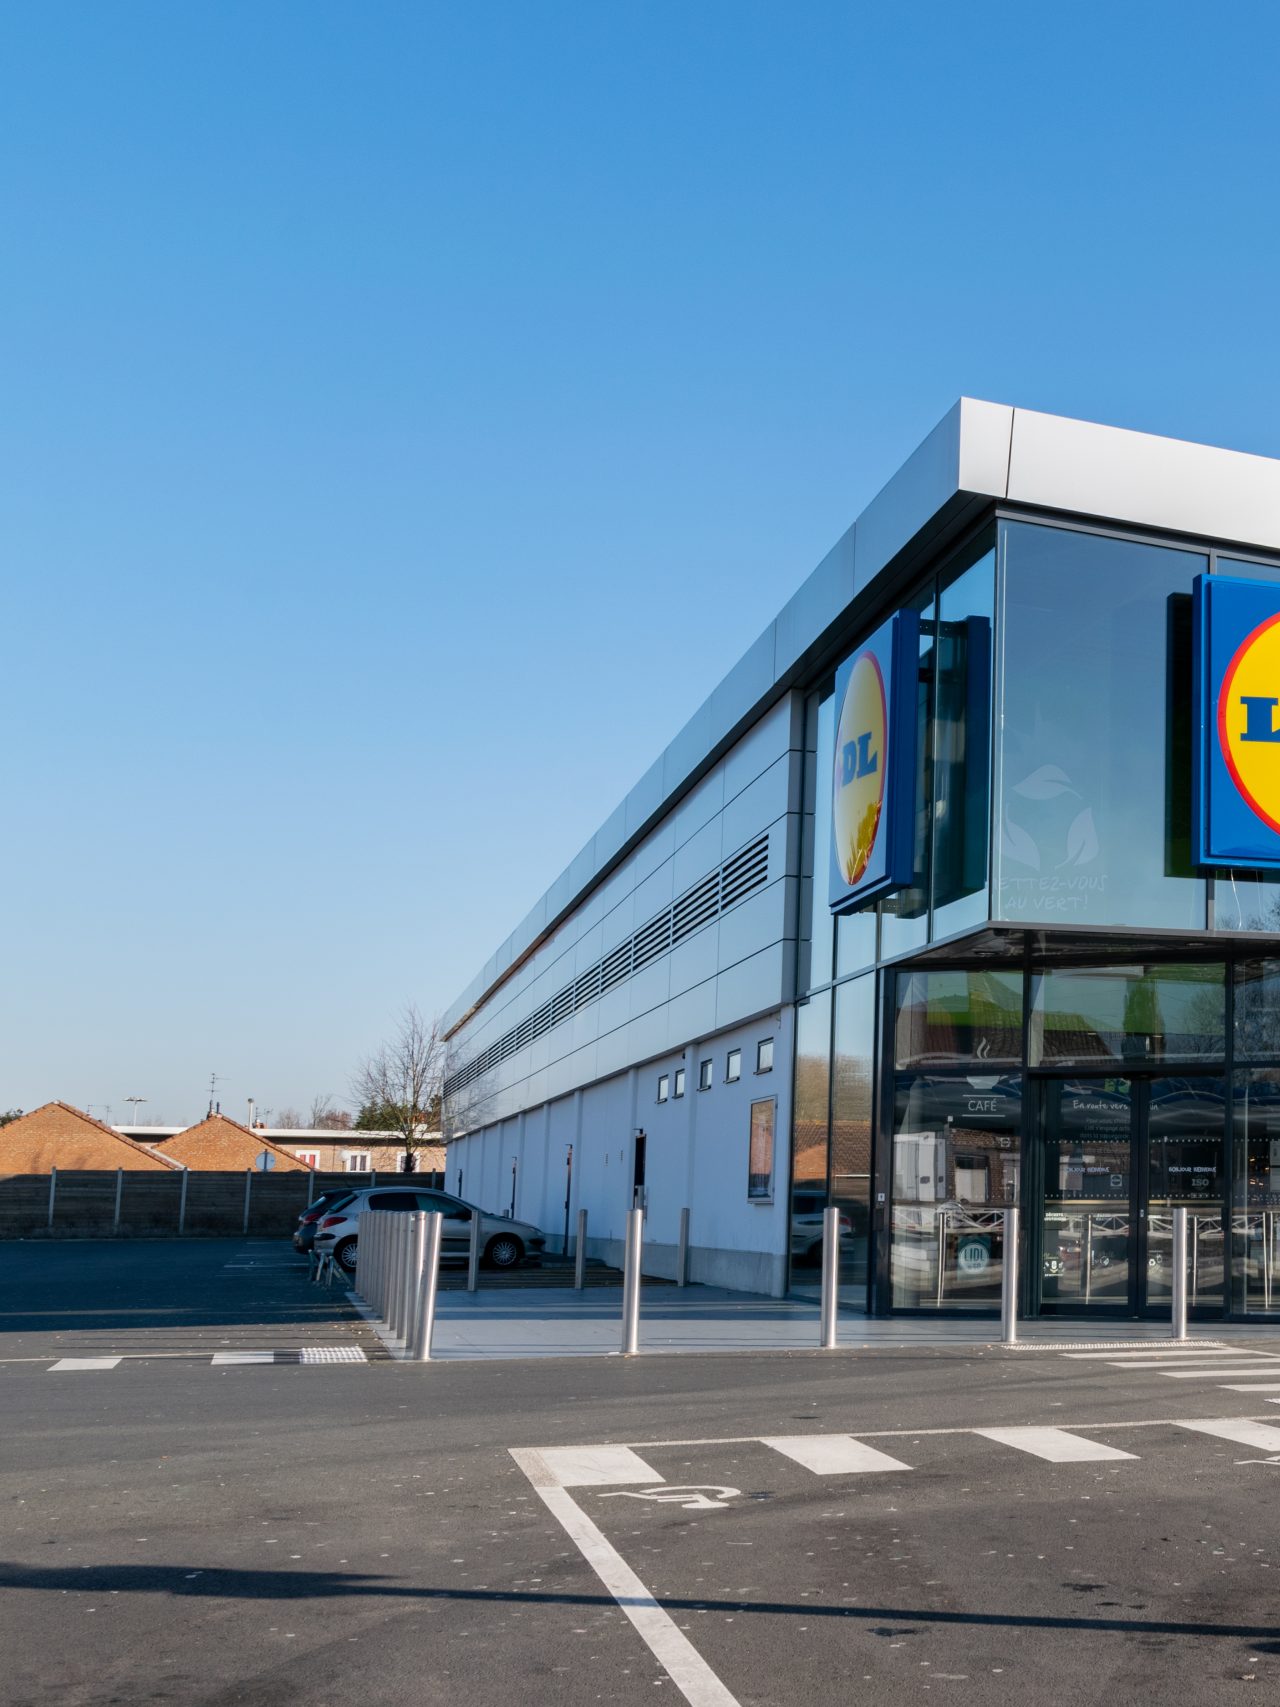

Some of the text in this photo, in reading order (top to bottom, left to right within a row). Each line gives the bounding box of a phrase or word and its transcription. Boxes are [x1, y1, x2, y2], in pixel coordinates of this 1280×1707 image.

[842, 731, 879, 787] DL
[1004, 896, 1027, 909] AU
[968, 1098, 997, 1111] CAFÉ
[1072, 1099, 1084, 1109] En
[1086, 1100, 1108, 1109] route
[964, 1247, 985, 1261] LIDL
